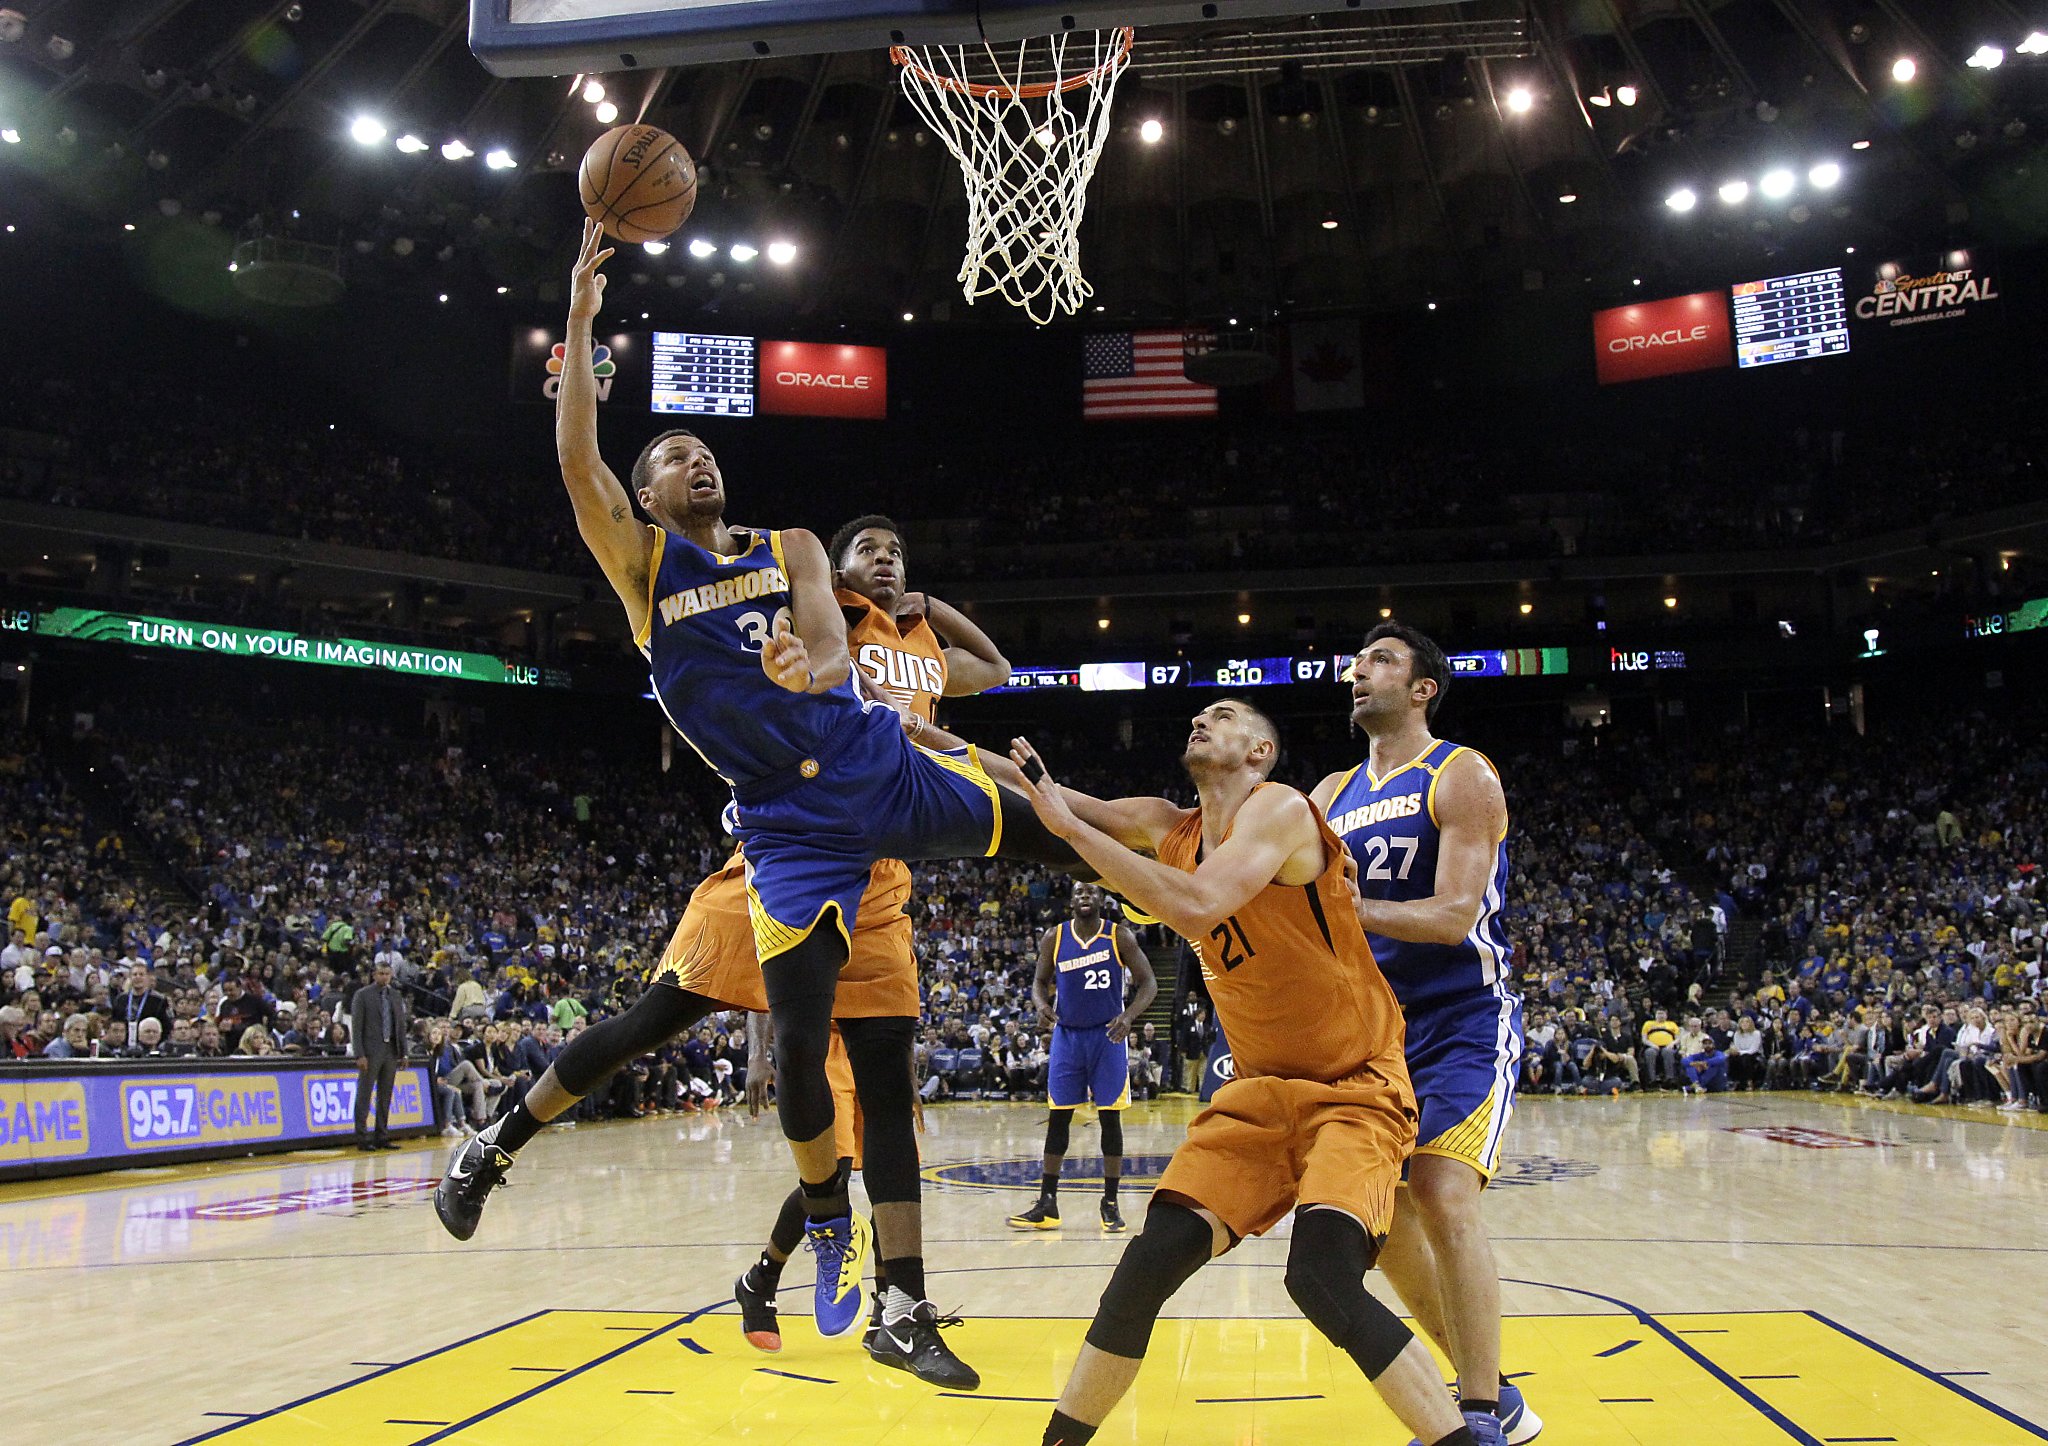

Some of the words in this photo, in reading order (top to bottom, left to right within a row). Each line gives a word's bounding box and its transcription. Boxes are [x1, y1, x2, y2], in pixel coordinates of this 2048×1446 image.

[1855, 277, 1998, 319] CENTRAL
[1608, 325, 1708, 352] ORACLE
[776, 372, 870, 389] ORACLE
[659, 567, 789, 627] WARRIORS
[1963, 613, 2003, 639] hue
[128, 620, 193, 645] TURN
[202, 629, 237, 650] ON
[245, 633, 308, 658] YOUR
[316, 640, 463, 675] IMAGINATION
[1611, 647, 1648, 671] hue
[504, 658, 540, 685] hue
[858, 643, 943, 696] SUNS
[1152, 666, 1180, 684] 67
[1216, 668, 1262, 685] 8:10
[1228, 659, 1248, 669] 3rd
[1297, 661, 1326, 679] 67
[1058, 674, 1068, 685] 4
[1070, 673, 1078, 685] 1
[1364, 834, 1419, 881] 27
[1210, 915, 1256, 972] 21
[1058, 949, 1110, 973] WARRIORS
[1084, 969, 1111, 990] 23
[129, 1088, 194, 1138] 95.7
[207, 1088, 278, 1130] GAME
[310, 1081, 357, 1123] 95.7
